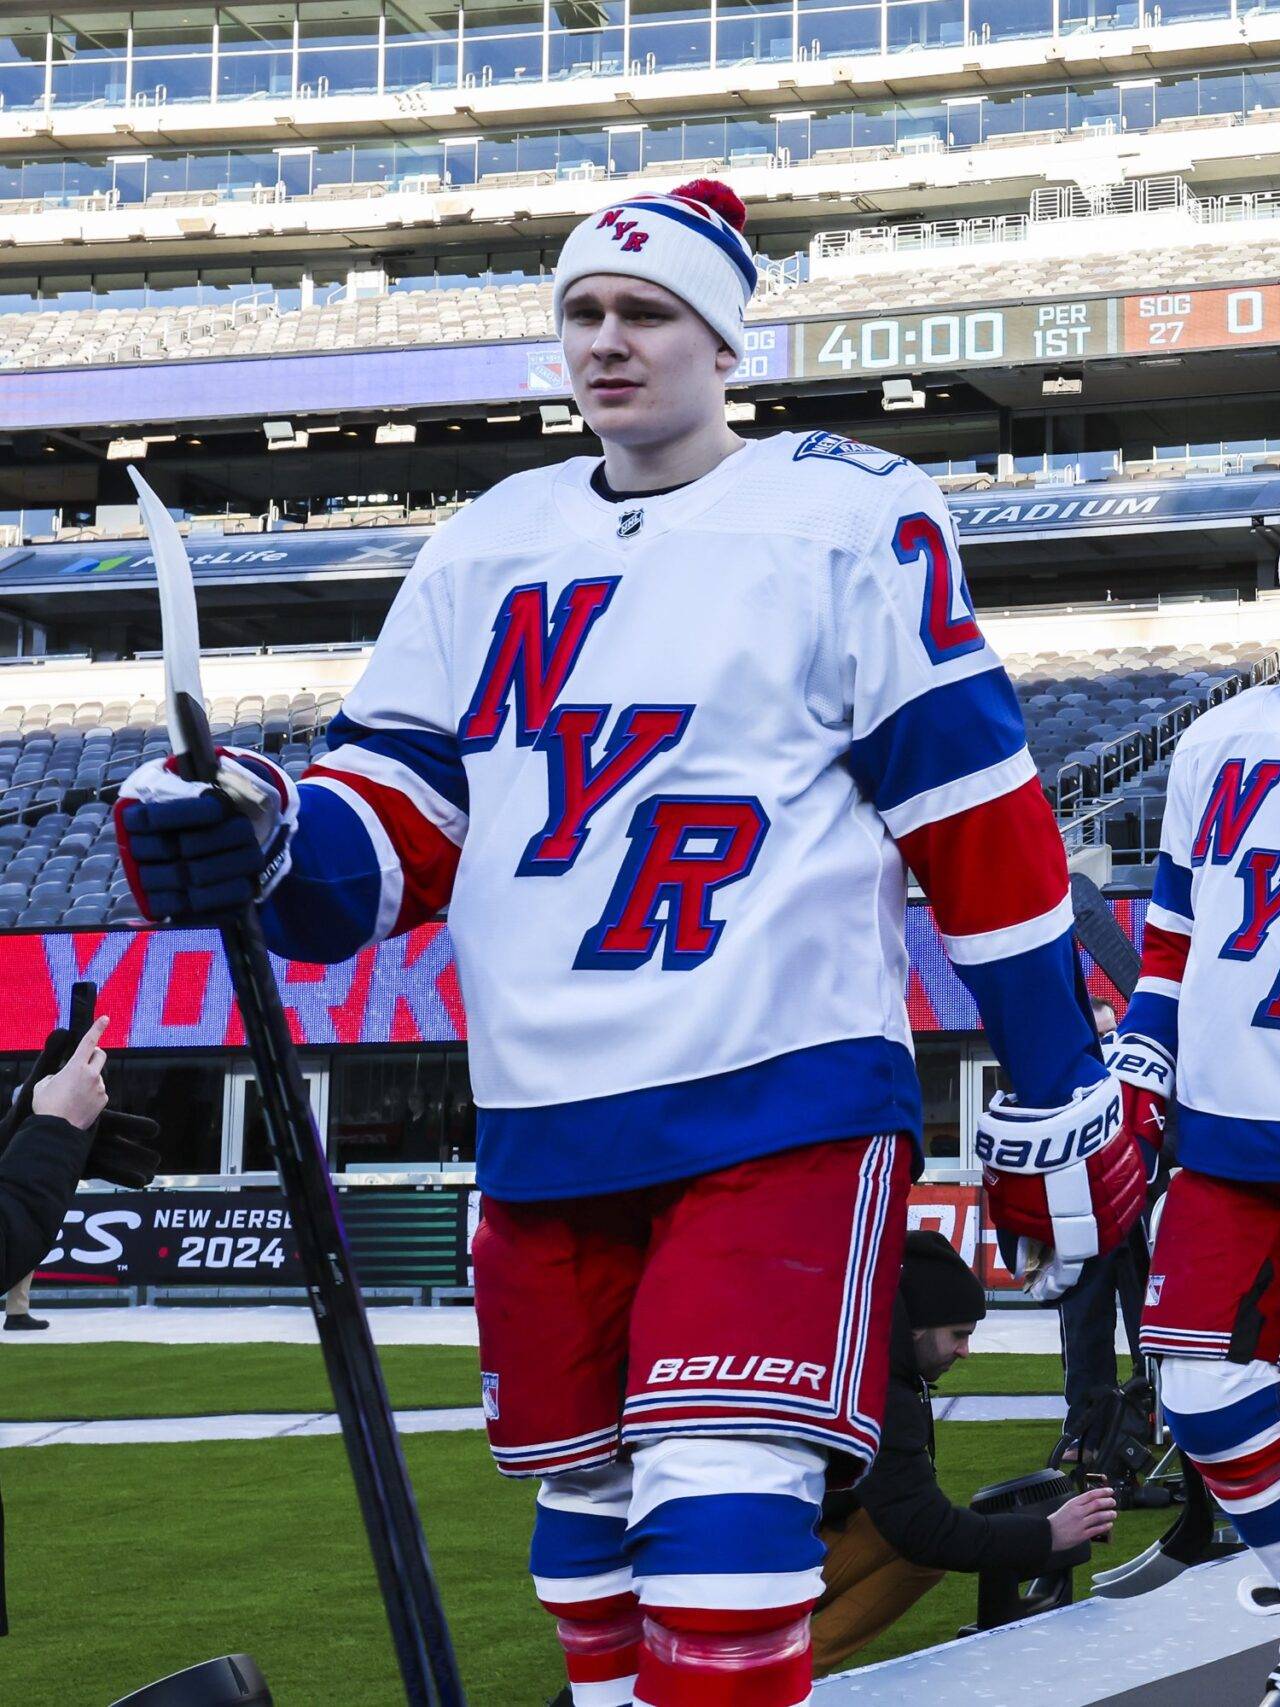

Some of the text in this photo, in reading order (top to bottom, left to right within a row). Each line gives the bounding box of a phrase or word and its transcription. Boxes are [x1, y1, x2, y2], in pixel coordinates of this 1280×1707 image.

[596, 209, 649, 252] NYR
[1038, 303, 1087, 327] PER
[1140, 295, 1191, 318] SOG
[743, 330, 775, 350] OG
[817, 312, 1004, 370] 40:00
[1033, 326, 1091, 358] 1ST
[1149, 321, 1184, 344] 27
[949, 496, 1161, 525] STADIUM
[130, 550, 288, 568] MtLife
[456, 575, 771, 971] NYR
[154, 1209, 293, 1229] NEW JERSE
[177, 1236, 285, 1268] 2024
